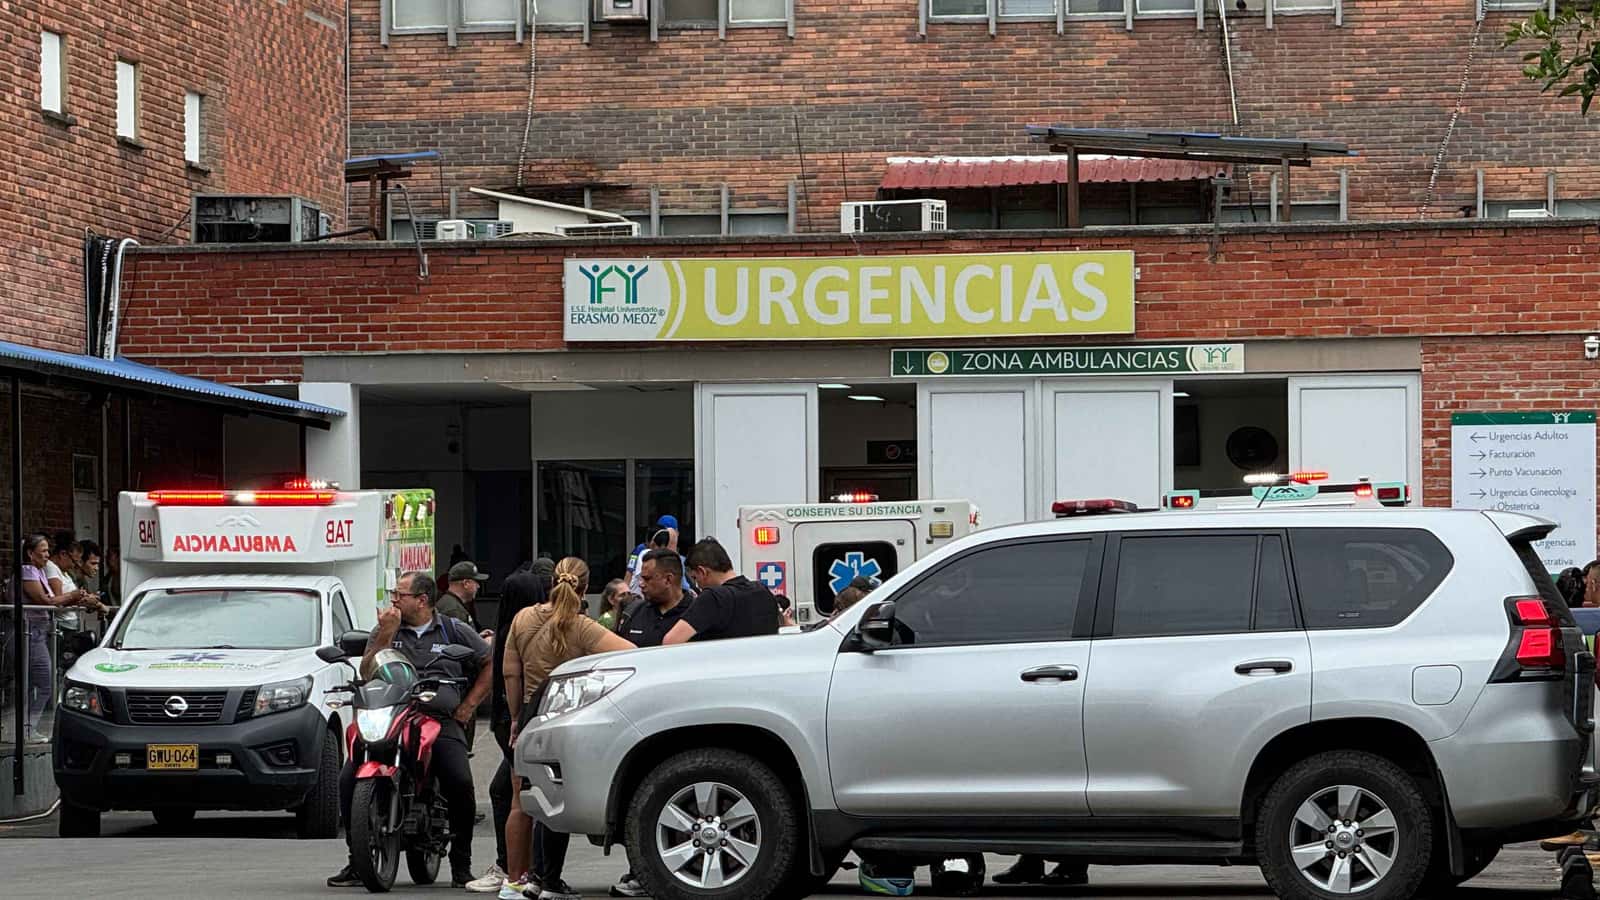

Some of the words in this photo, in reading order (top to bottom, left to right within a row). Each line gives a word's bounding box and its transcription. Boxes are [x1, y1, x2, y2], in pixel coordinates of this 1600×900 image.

[703, 262, 1108, 326] URGENCIAS
[588, 305, 615, 314] Hospital
[617, 305, 658, 313] Universitario
[570, 312, 620, 325] ERASMO
[962, 351, 1023, 370] ZONA
[1028, 351, 1180, 370] AMBULANCIAS
[1488, 431, 1532, 443] Urgencias
[1534, 430, 1569, 441] Adultos
[1489, 467, 1513, 477] Punto
[1515, 466, 1562, 477] Vacunación
[1489, 487, 1528, 500] Urgencias
[786, 505, 846, 518] CONSERVE
[849, 505, 863, 517] SU
[866, 504, 923, 516] DISTANCIA
[1497, 501, 1540, 511] Obstetricia
